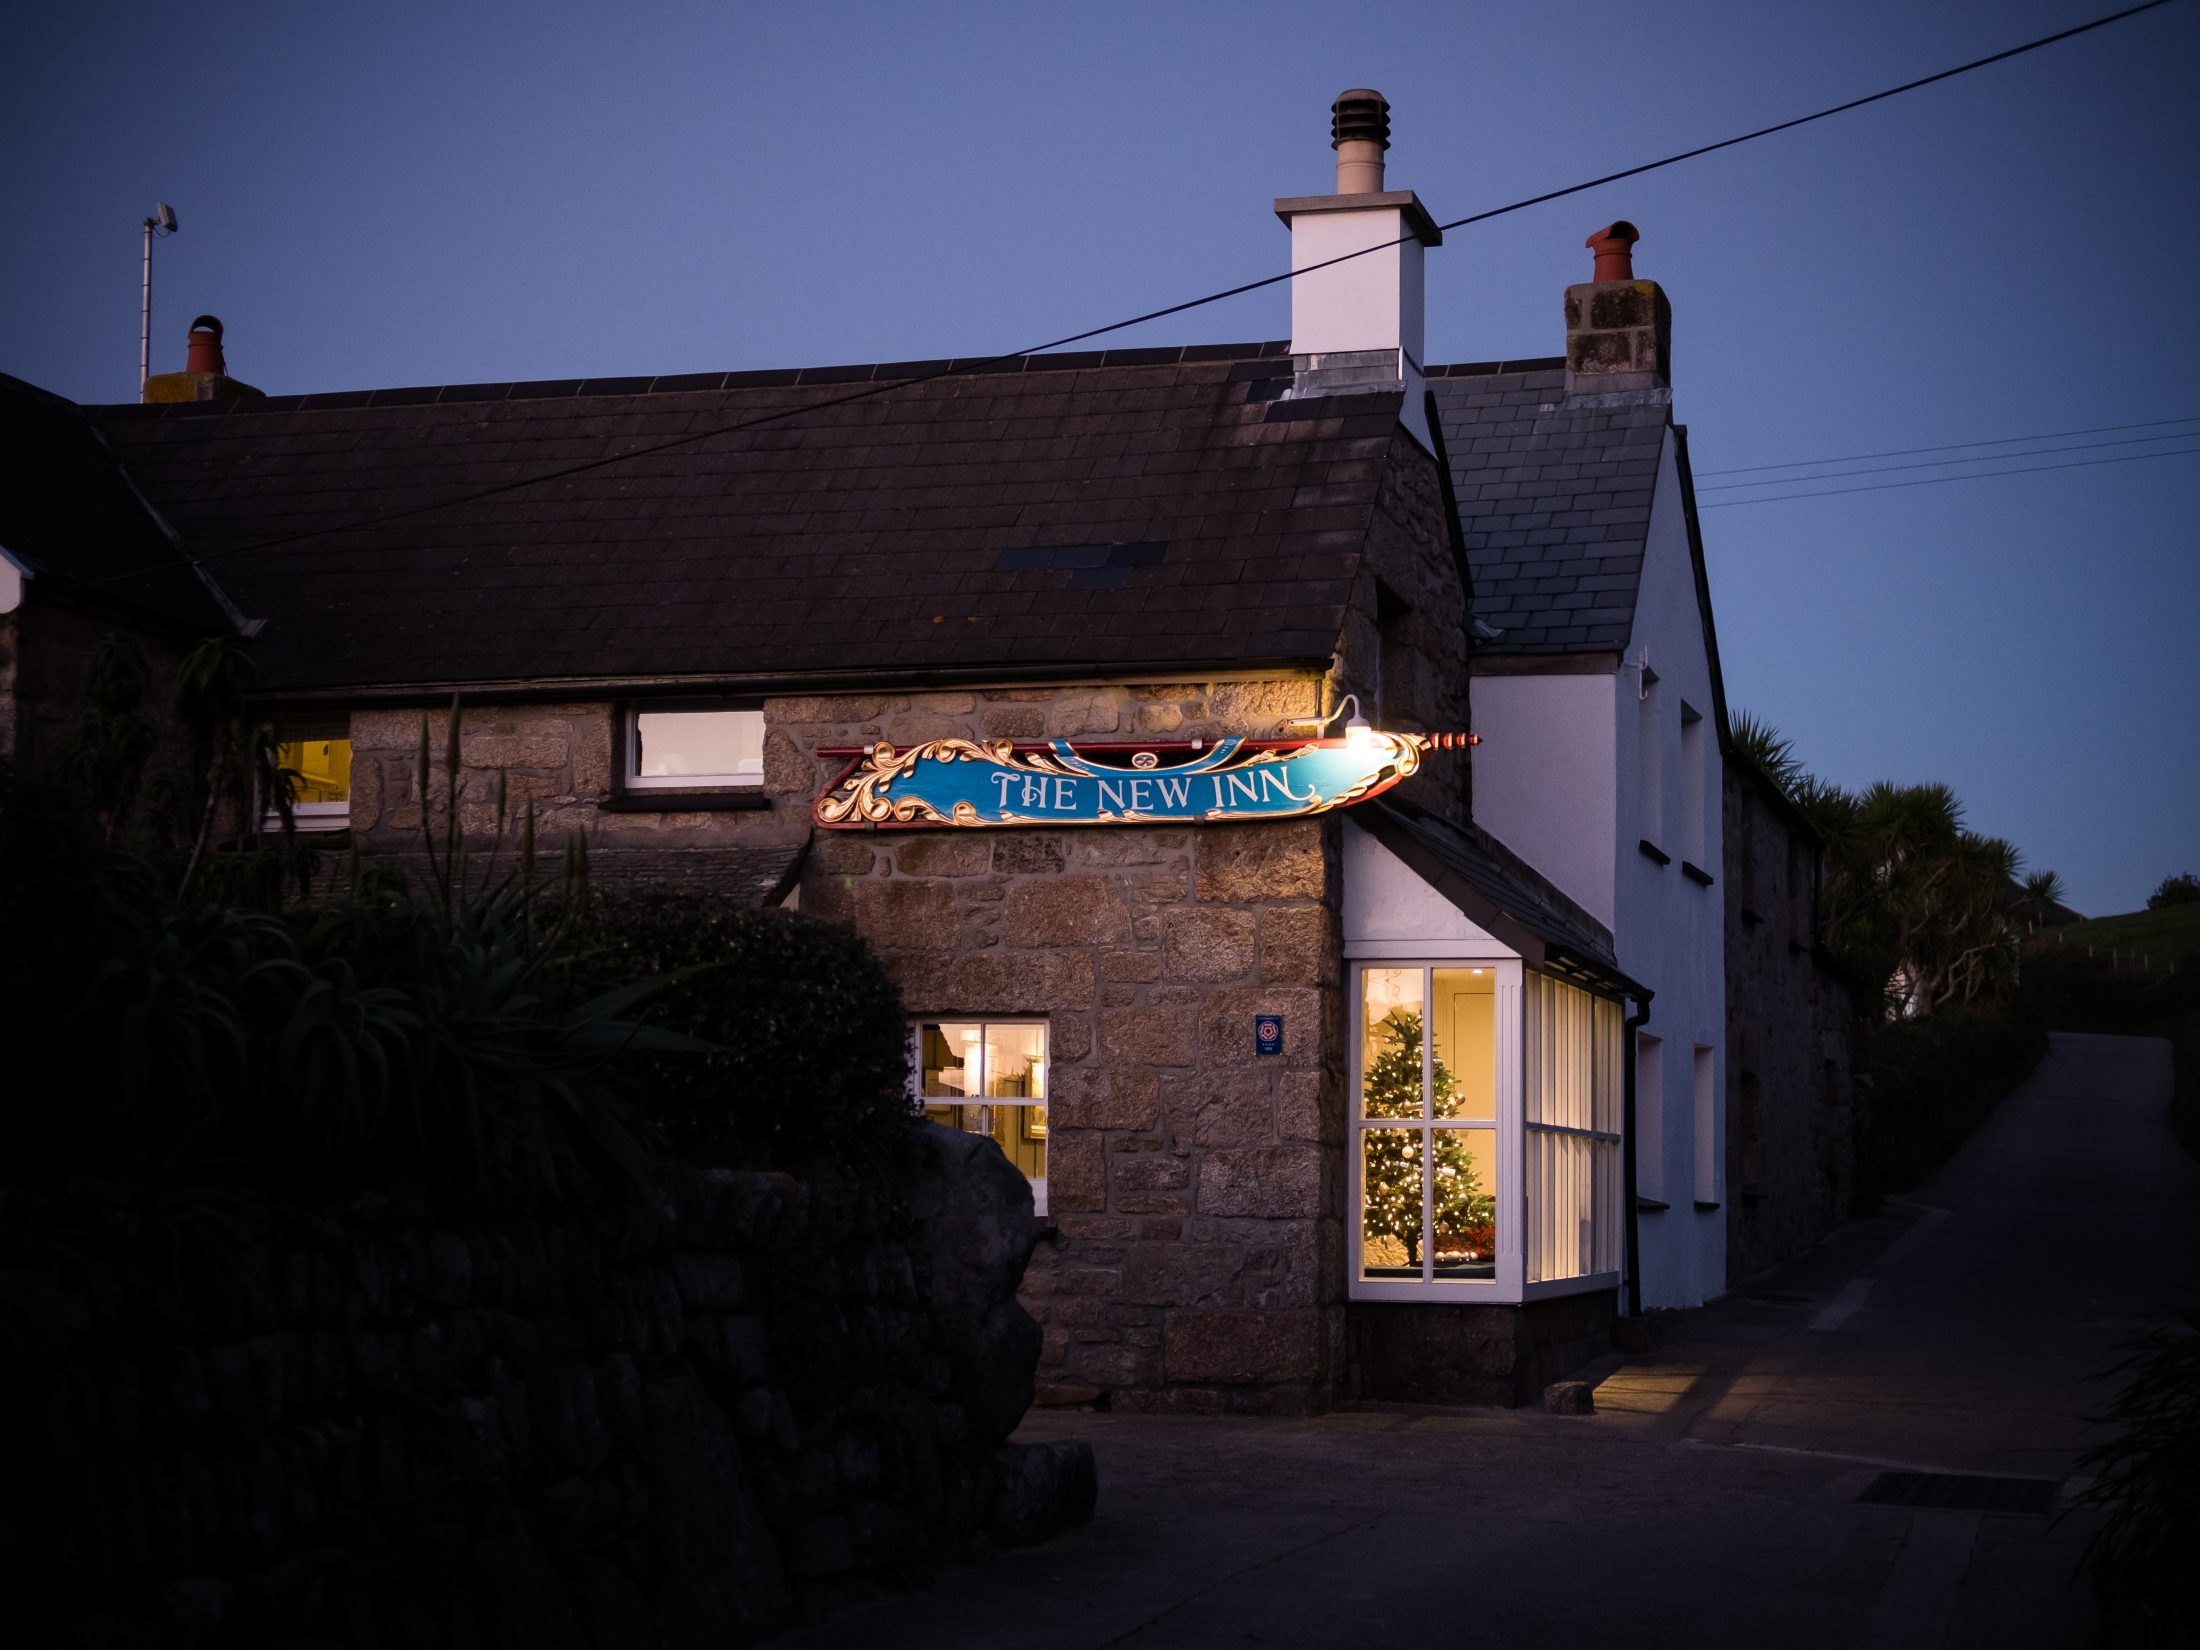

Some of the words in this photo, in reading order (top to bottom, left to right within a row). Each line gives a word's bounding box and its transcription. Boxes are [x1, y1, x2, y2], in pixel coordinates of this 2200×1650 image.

[991, 772, 1077, 810] THE
[1097, 778, 1192, 810] NEW
[1212, 766, 1316, 807] INN
